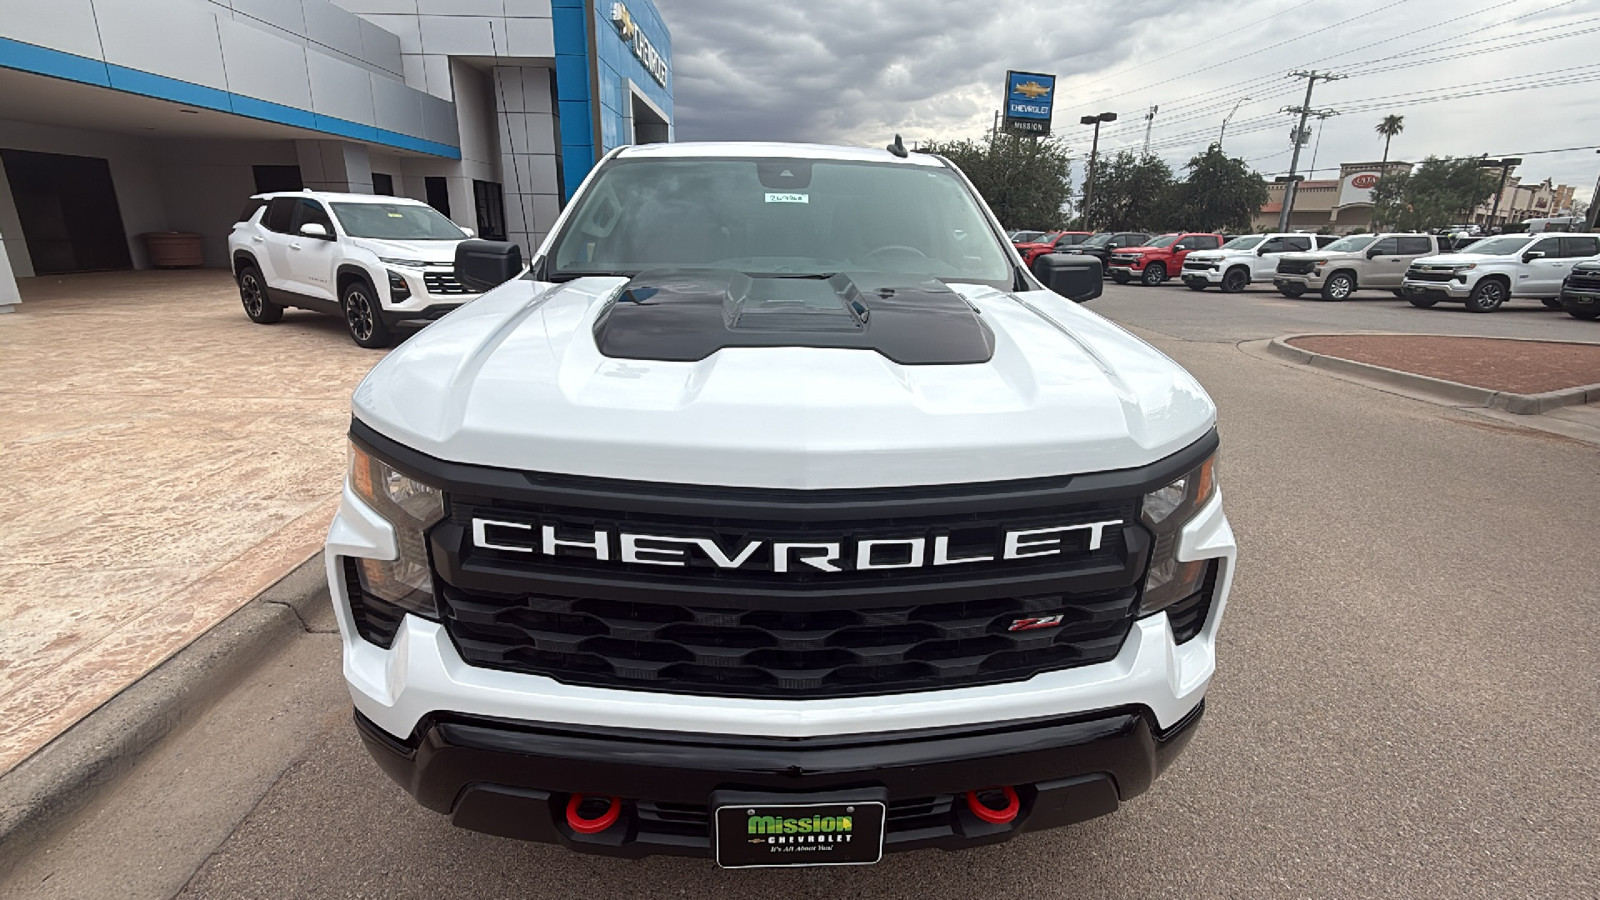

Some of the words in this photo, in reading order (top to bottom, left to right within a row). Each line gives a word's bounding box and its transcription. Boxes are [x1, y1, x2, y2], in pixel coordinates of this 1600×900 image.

[633, 23, 667, 88] CHEVROLET
[1011, 104, 1049, 114] CHEVROLET
[1014, 122, 1043, 131] MISSION
[472, 518, 1123, 573] CHEVROLET
[1008, 614, 1064, 631] Z71
[748, 815, 852, 834] Mission
[768, 835, 852, 844] CHEVROLET
